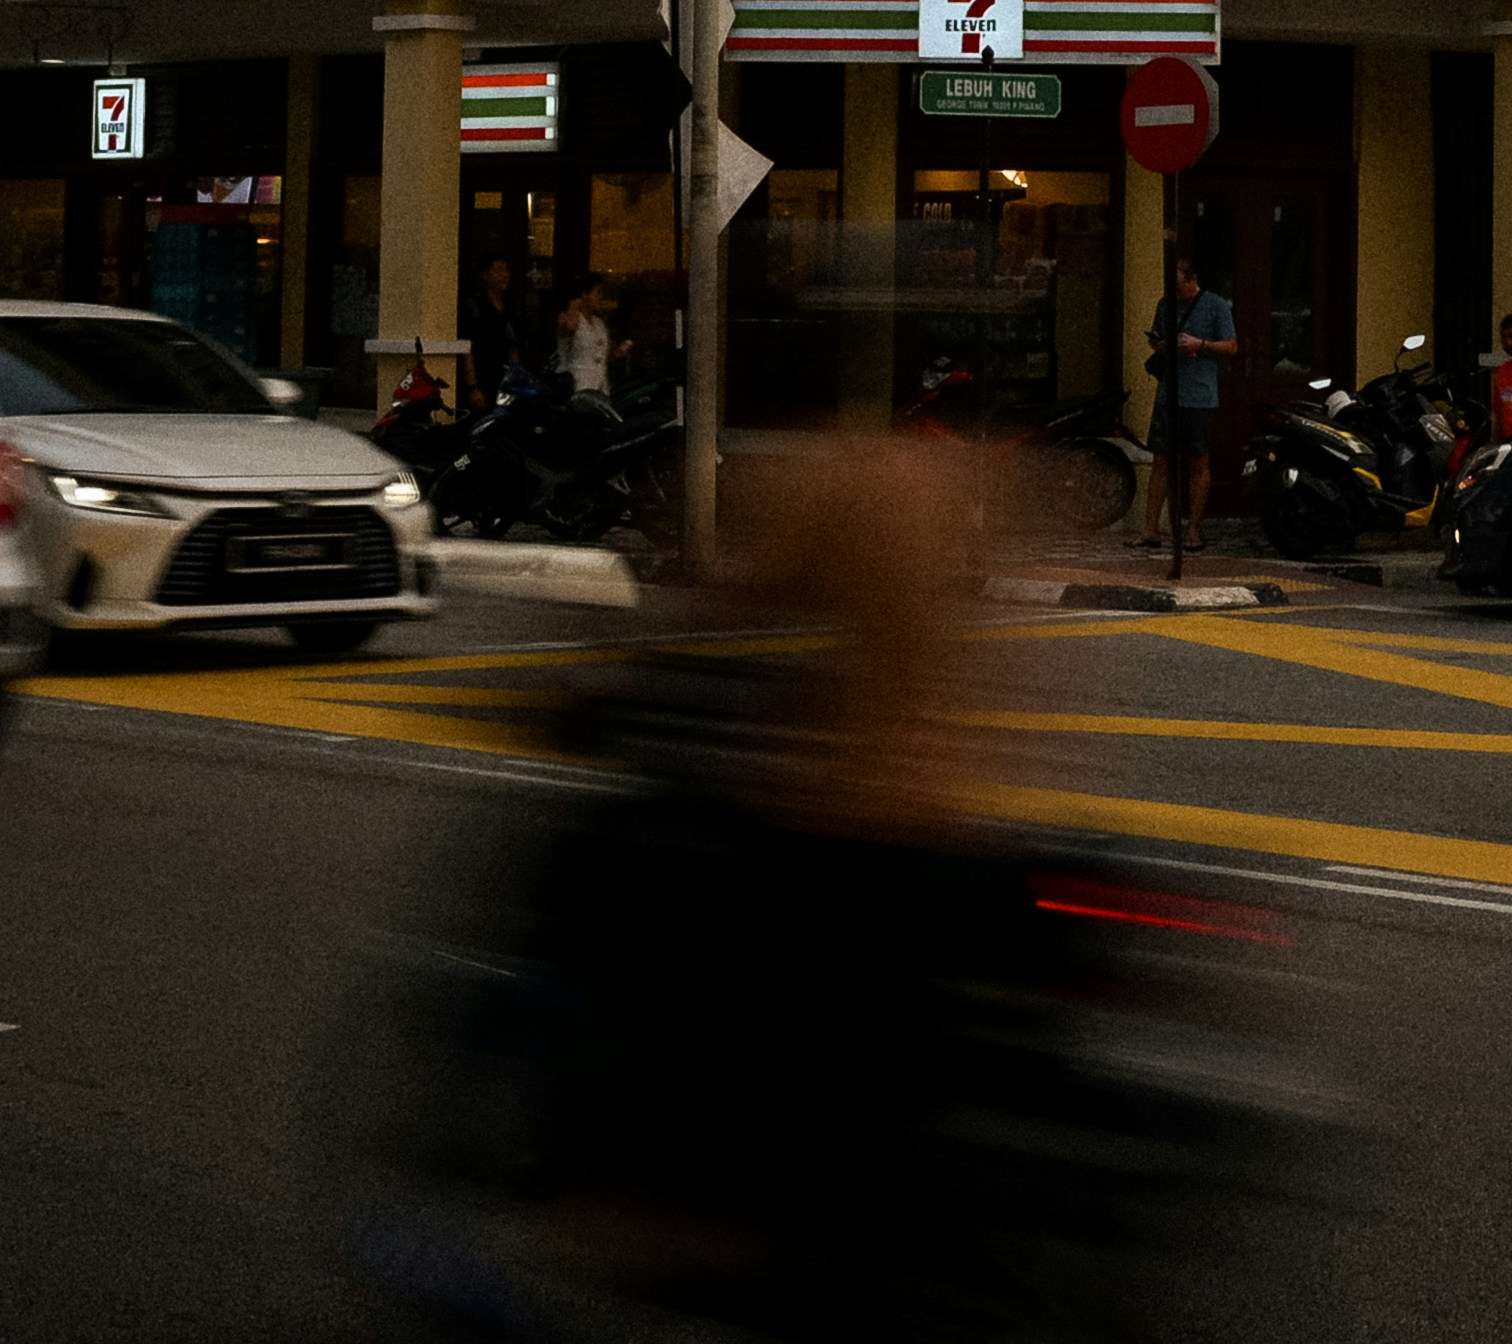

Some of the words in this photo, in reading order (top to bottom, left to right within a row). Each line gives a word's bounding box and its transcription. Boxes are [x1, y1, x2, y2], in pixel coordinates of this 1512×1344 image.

[945, 78, 994, 98] LEBUH
[1001, 80, 1037, 99] KING
[103, 96, 125, 150] 7
